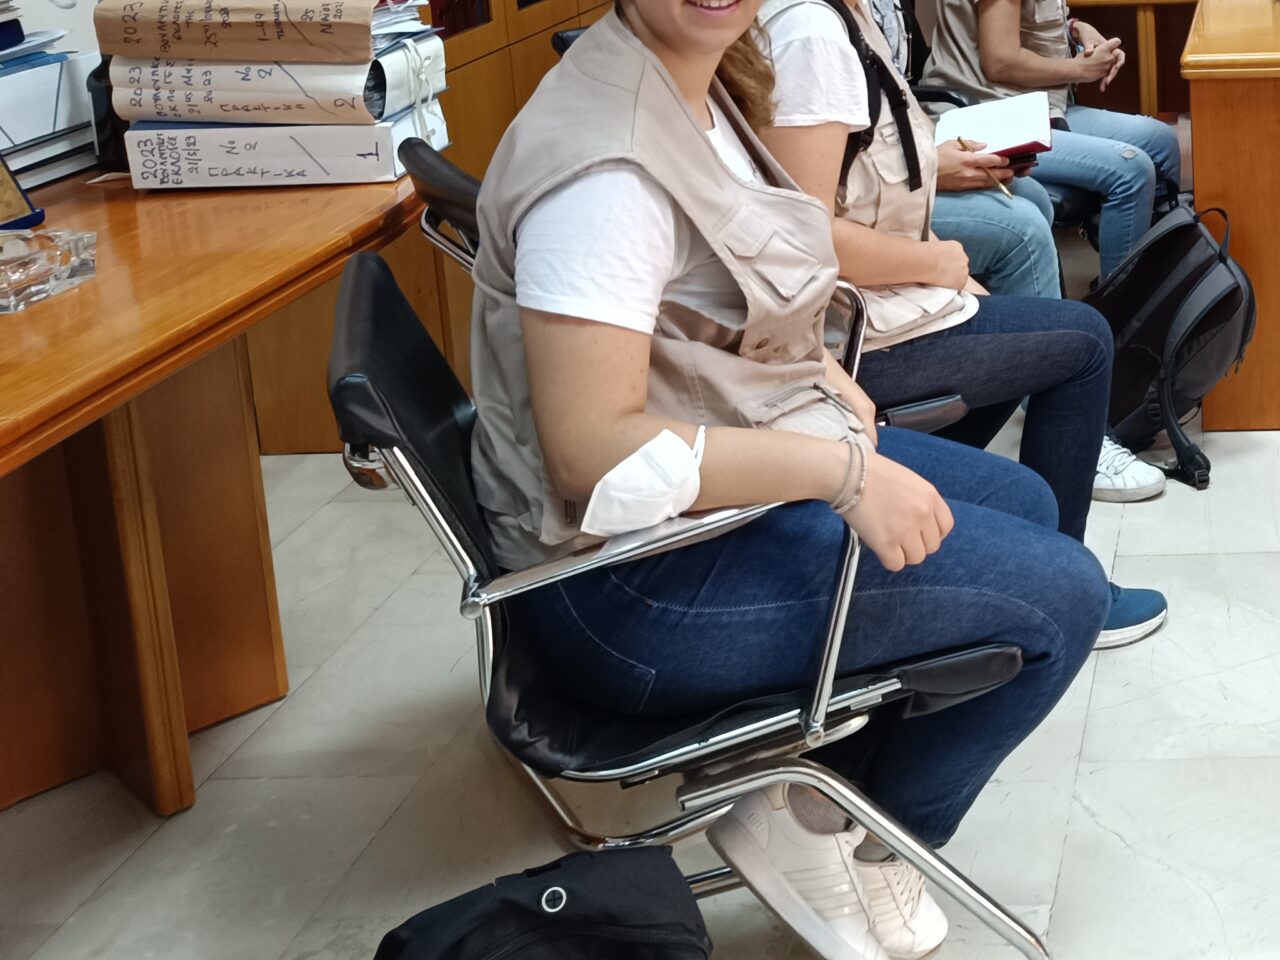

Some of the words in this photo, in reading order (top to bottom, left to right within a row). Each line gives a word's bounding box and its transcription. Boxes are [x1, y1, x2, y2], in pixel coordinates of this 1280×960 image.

[121, 1, 143, 45] 2023
[128, 66, 143, 107] 2023
[333, 96, 356, 109] 2
[137, 138, 158, 181] 2023
[356, 141, 380, 162] 1
